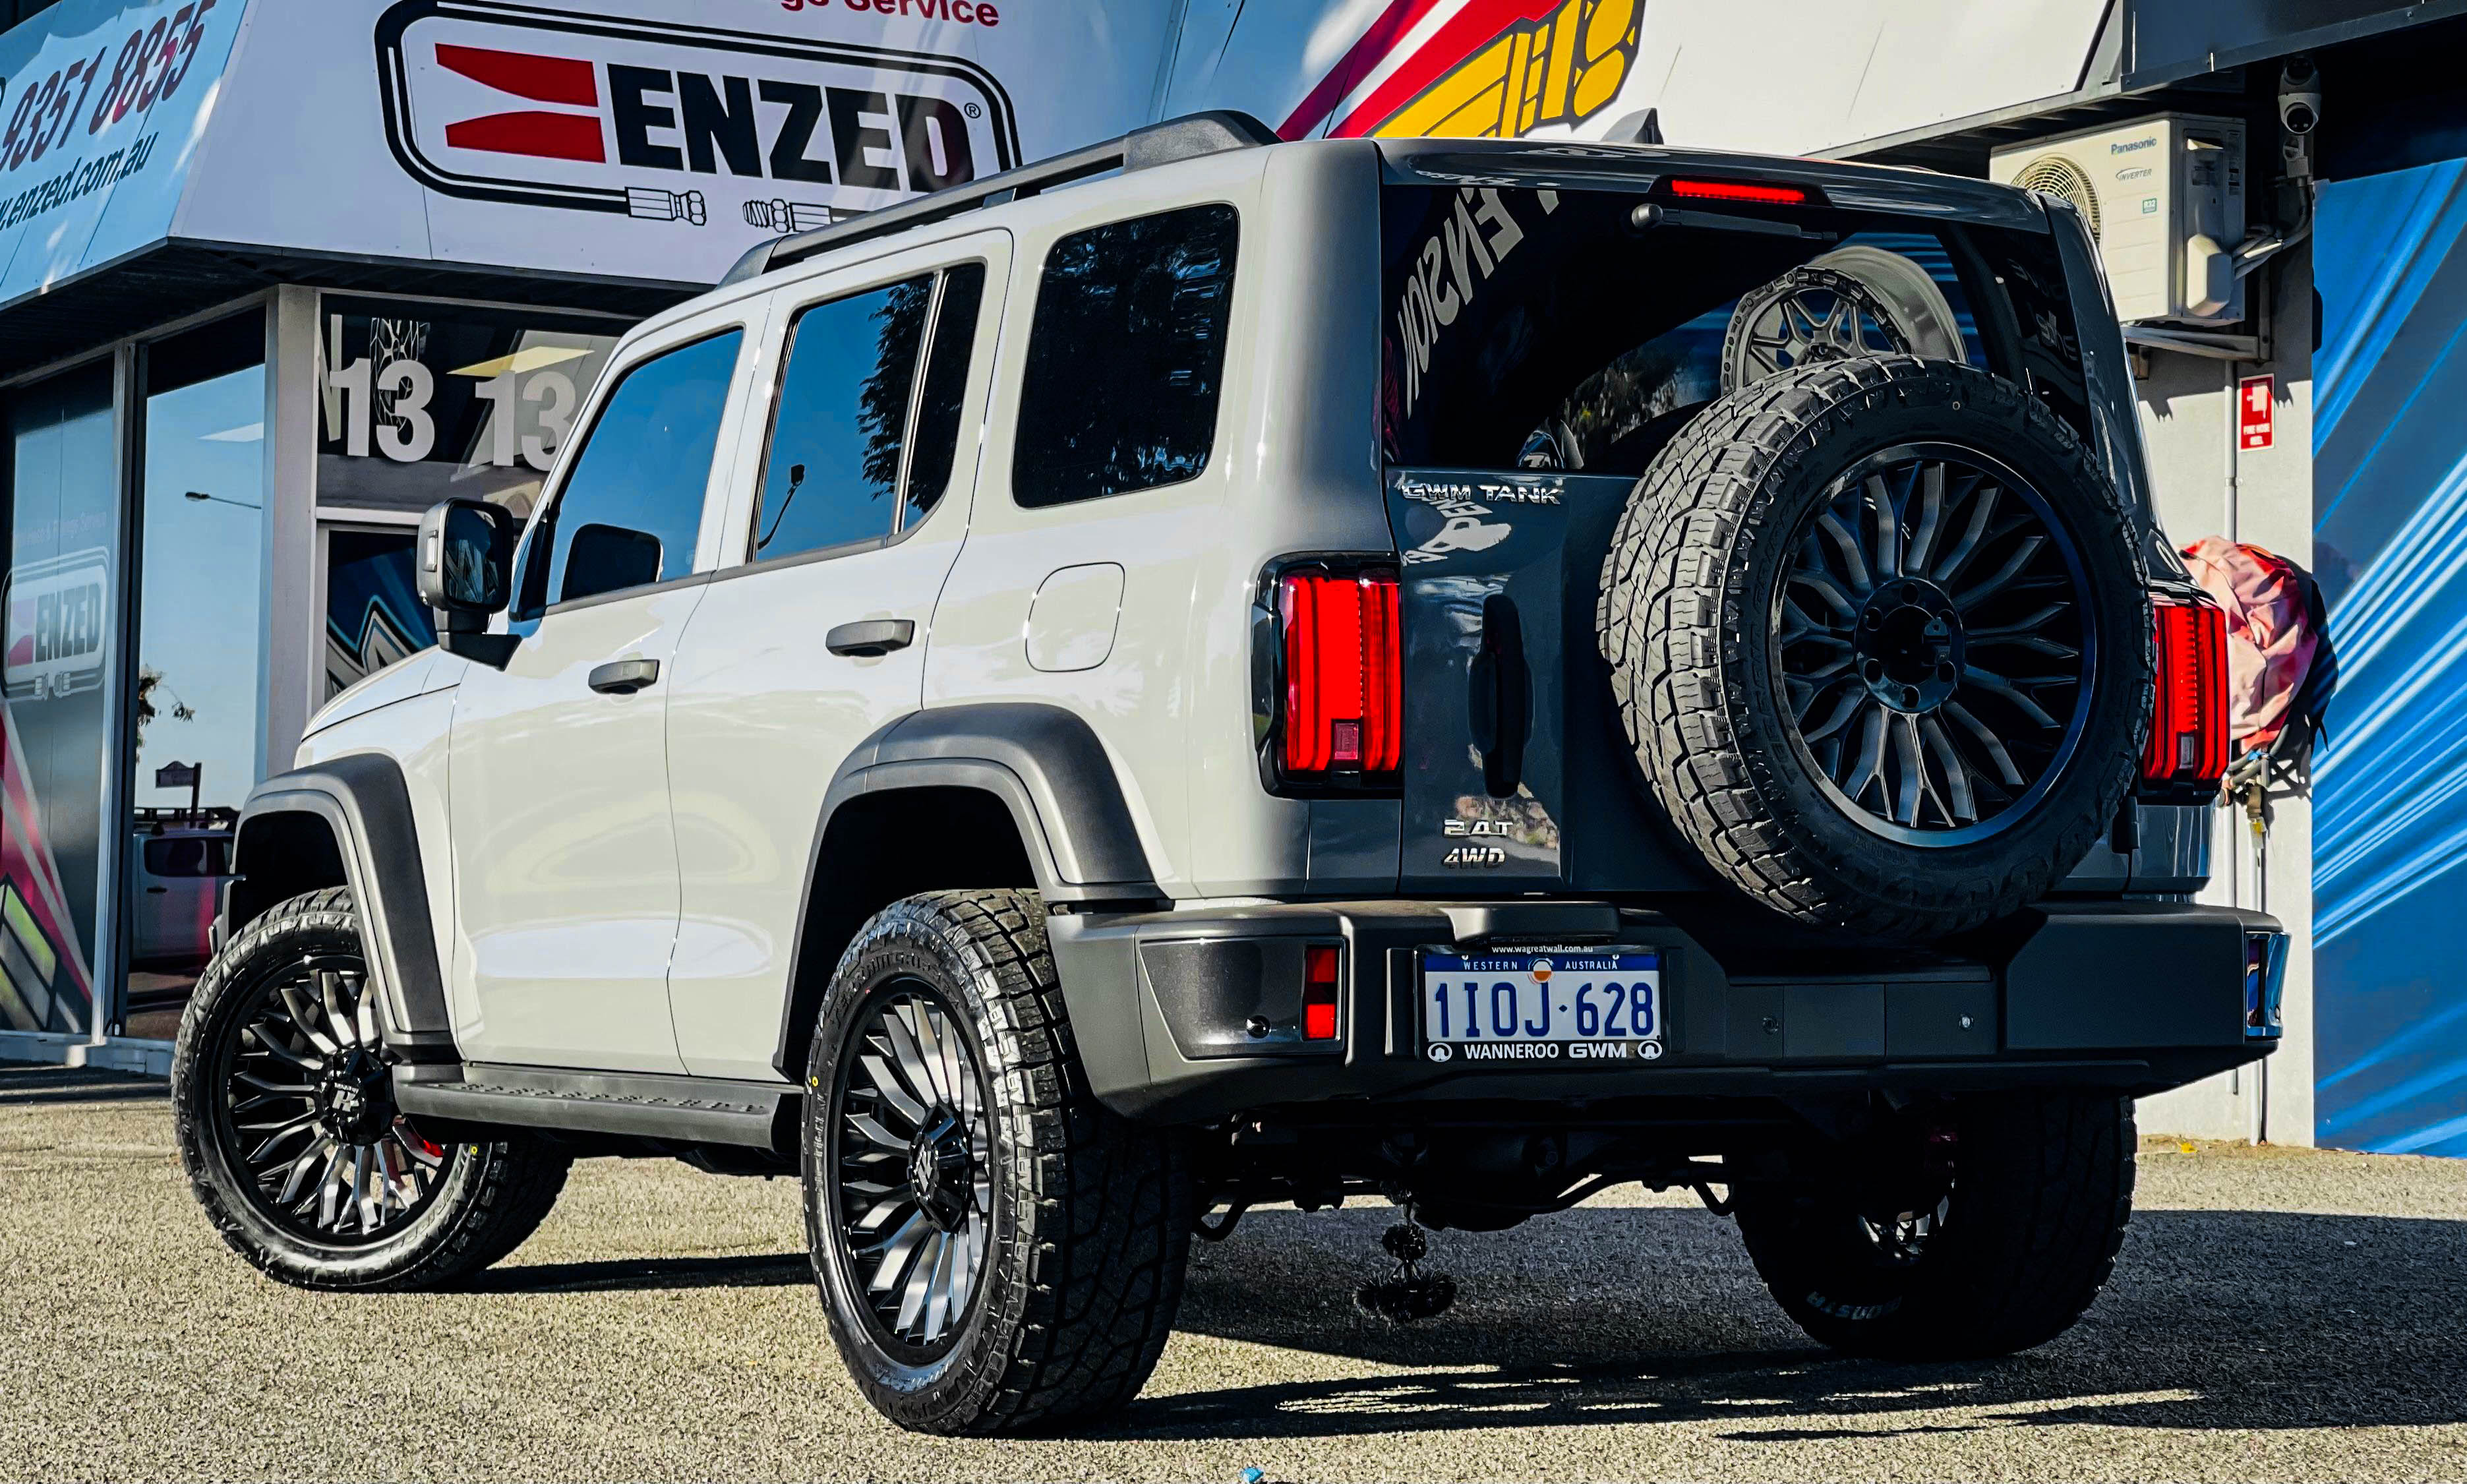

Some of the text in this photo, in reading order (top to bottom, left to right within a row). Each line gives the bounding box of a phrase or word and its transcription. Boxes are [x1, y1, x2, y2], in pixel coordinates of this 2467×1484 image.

[88, 0, 216, 135] 8855
[607, 63, 975, 193] ENZED
[2111, 136, 2156, 155] Panasonic
[2119, 168, 2152, 181] INVERTER
[330, 358, 435, 462] 13
[1402, 483, 1560, 504] GWM TANK
[36, 582, 101, 663] ENZED
[1444, 848, 1505, 866] 4WD
[1491, 944, 1594, 954] www.wagreatwall.com.au
[1463, 961, 1618, 970] WESTERN AUSTRALIA
[1464, 1043, 1627, 1060] WANNEROO GWM
